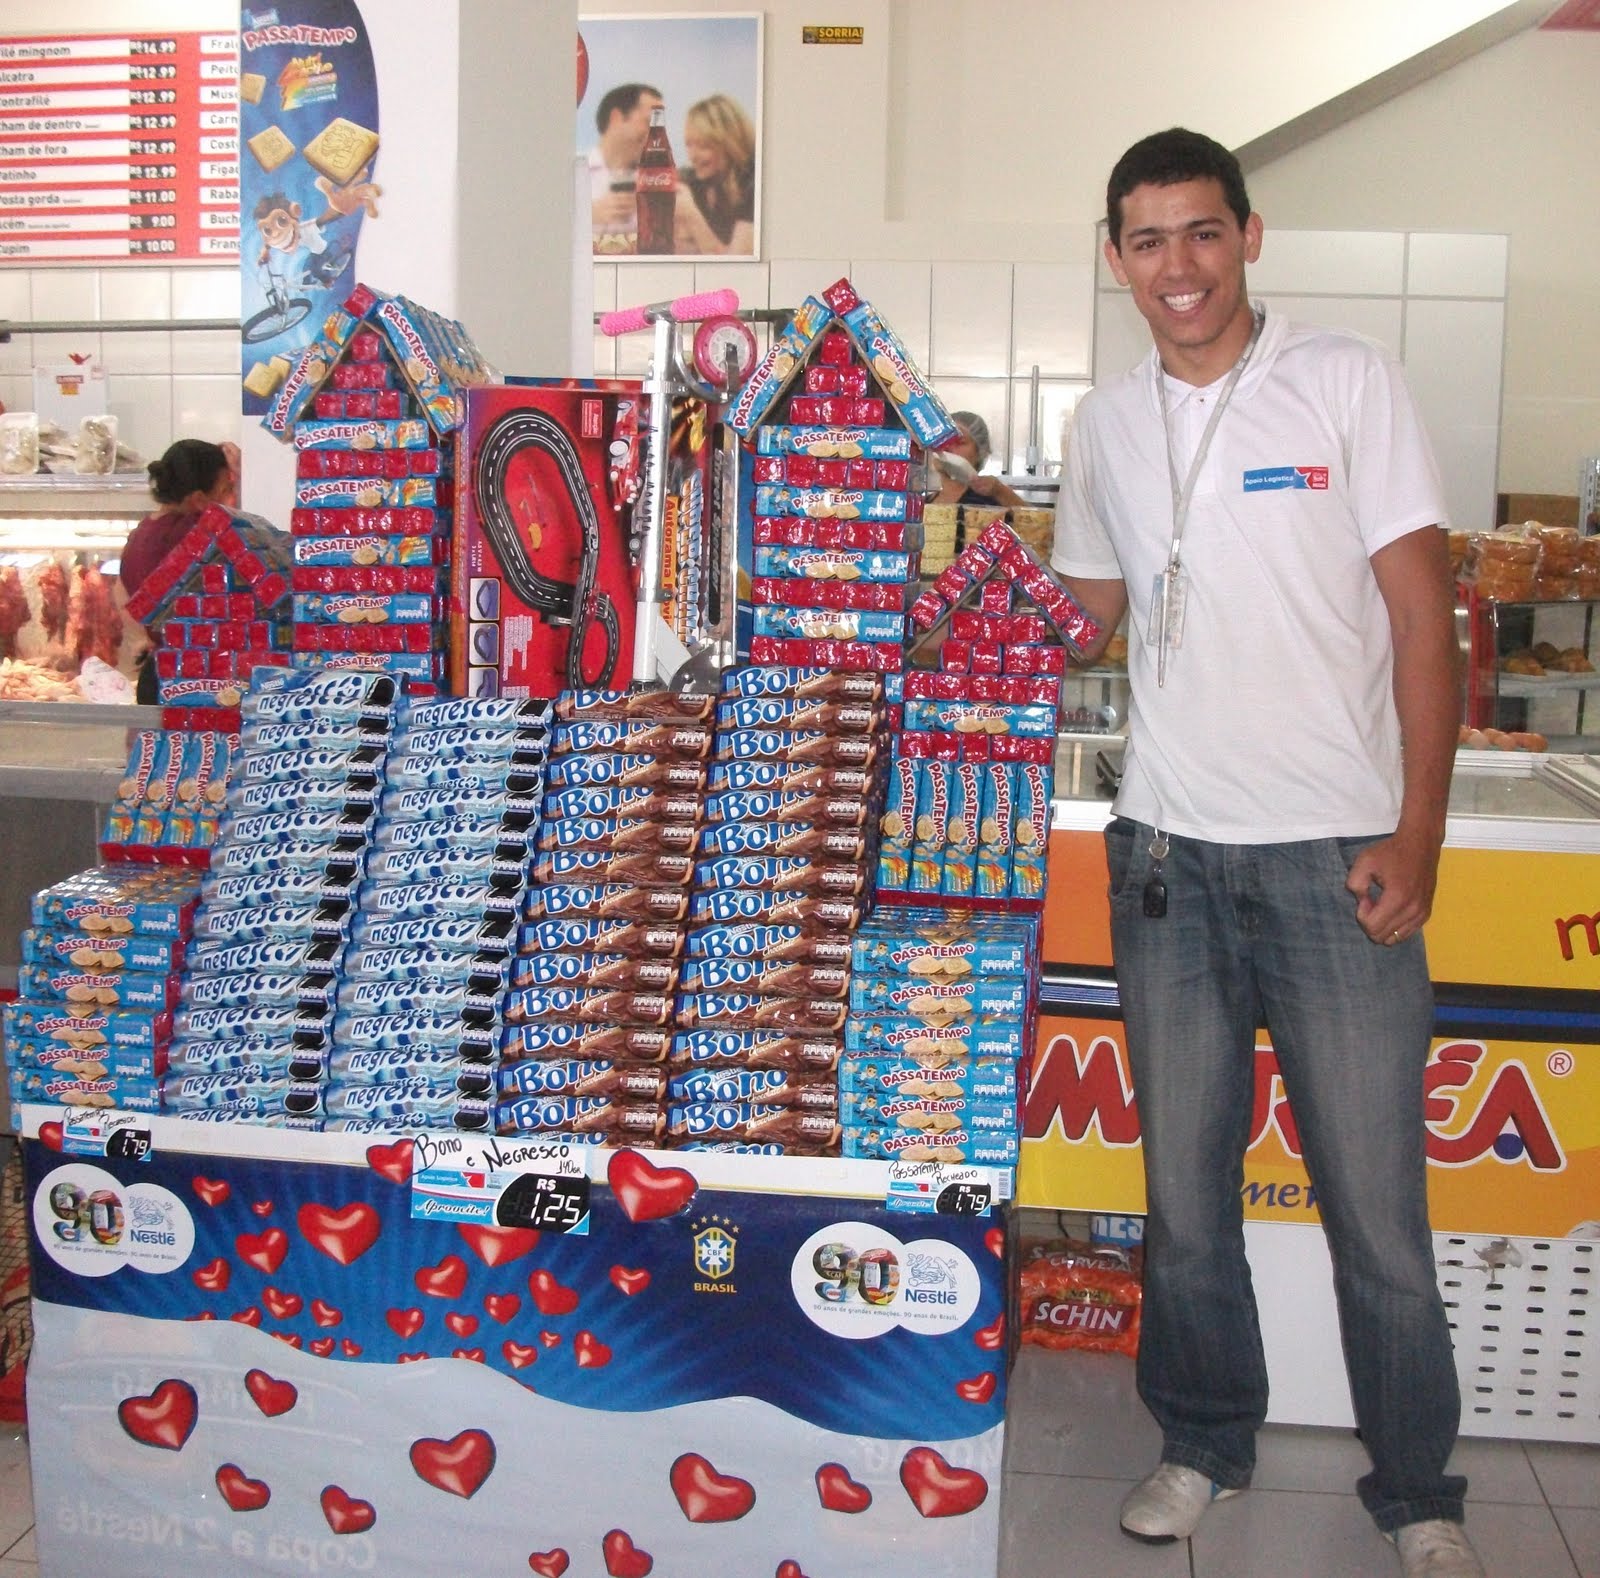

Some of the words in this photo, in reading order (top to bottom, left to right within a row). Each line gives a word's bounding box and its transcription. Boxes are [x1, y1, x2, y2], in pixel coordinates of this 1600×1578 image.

[242, 24, 357, 52] PASSATEMPO
[819, 28, 863, 38] SORRIA!
[0, 96, 51, 107] ontrafilé
[0, 121, 25, 131] ham
[0, 146, 25, 156] ham
[0, 170, 37, 180] atinho
[0, 195, 25, 205] osta
[0, 218, 25, 230] cém
[382, 303, 439, 377] PASSATEMPO
[873, 337, 925, 398] PASSATEMPO
[272, 349, 315, 432] PASSATEMPO
[733, 342, 782, 429] PASSATEMPO
[296, 422, 378, 449] PASSATEMPO
[792, 430, 867, 449] PASSATEMPO
[299, 478, 384, 503] PASSATEMPO
[299, 536, 382, 560] PASSATEMPO
[663, 500, 677, 578] Autorama
[792, 552, 864, 568] PASSATEMPO
[324, 595, 392, 615] PASSATEMPO
[325, 654, 392, 670] PASSATEMPO
[162, 678, 242, 701] PASSATEMPO
[259, 675, 363, 713] negresco
[134, 730, 156, 801] PASSATEMPO
[165, 731, 184, 803] PASSATEMPO
[196, 730, 216, 803] PASSATEMPO
[896, 758, 916, 841] PASSATEMPO
[927, 761, 947, 845] PASSATEMPO
[958, 763, 979, 847] PASSATEMPO
[989, 763, 1012, 847] PASSATEMPO
[1025, 764, 1047, 849] PASSATEMPO
[66, 904, 136, 920] PASSATEMPO
[56, 938, 128, 954] PASSATEMPO
[701, 925, 801, 958] Bono
[891, 943, 975, 965] PASSATEMPO
[51, 974, 122, 990] PASSATEMPO
[890, 983, 975, 1005] PASSATEMPO
[36, 1017, 109, 1034] PASSATEMPO
[887, 1025, 971, 1046] PASSATEMPO
[38, 1049, 109, 1065] PASSATEMPO
[46, 1080, 117, 1096] PASSATEMPO
[684, 1070, 788, 1102] Bono
[881, 1067, 967, 1088] PASSATEMPO
[880, 1098, 965, 1118] PASSATEMPO
[122, 1138, 149, 1156] 1,79
[883, 1132, 969, 1154] PASSATEMPO
[409, 1133, 463, 1177] Bono
[537, 1178, 557, 1191] R$
[49, 1182, 125, 1245] 90
[529, 1192, 581, 1225] 1,25
[955, 1194, 987, 1212] 1,79
[130, 1229, 176, 1246] Nestlé
[706, 1248, 722, 1256] CBF
[812, 1242, 901, 1306] 90
[693, 1282, 738, 1293] BRASIL
[905, 1288, 958, 1305] Nestlé
[1035, 1302, 1123, 1330] SCHIN
